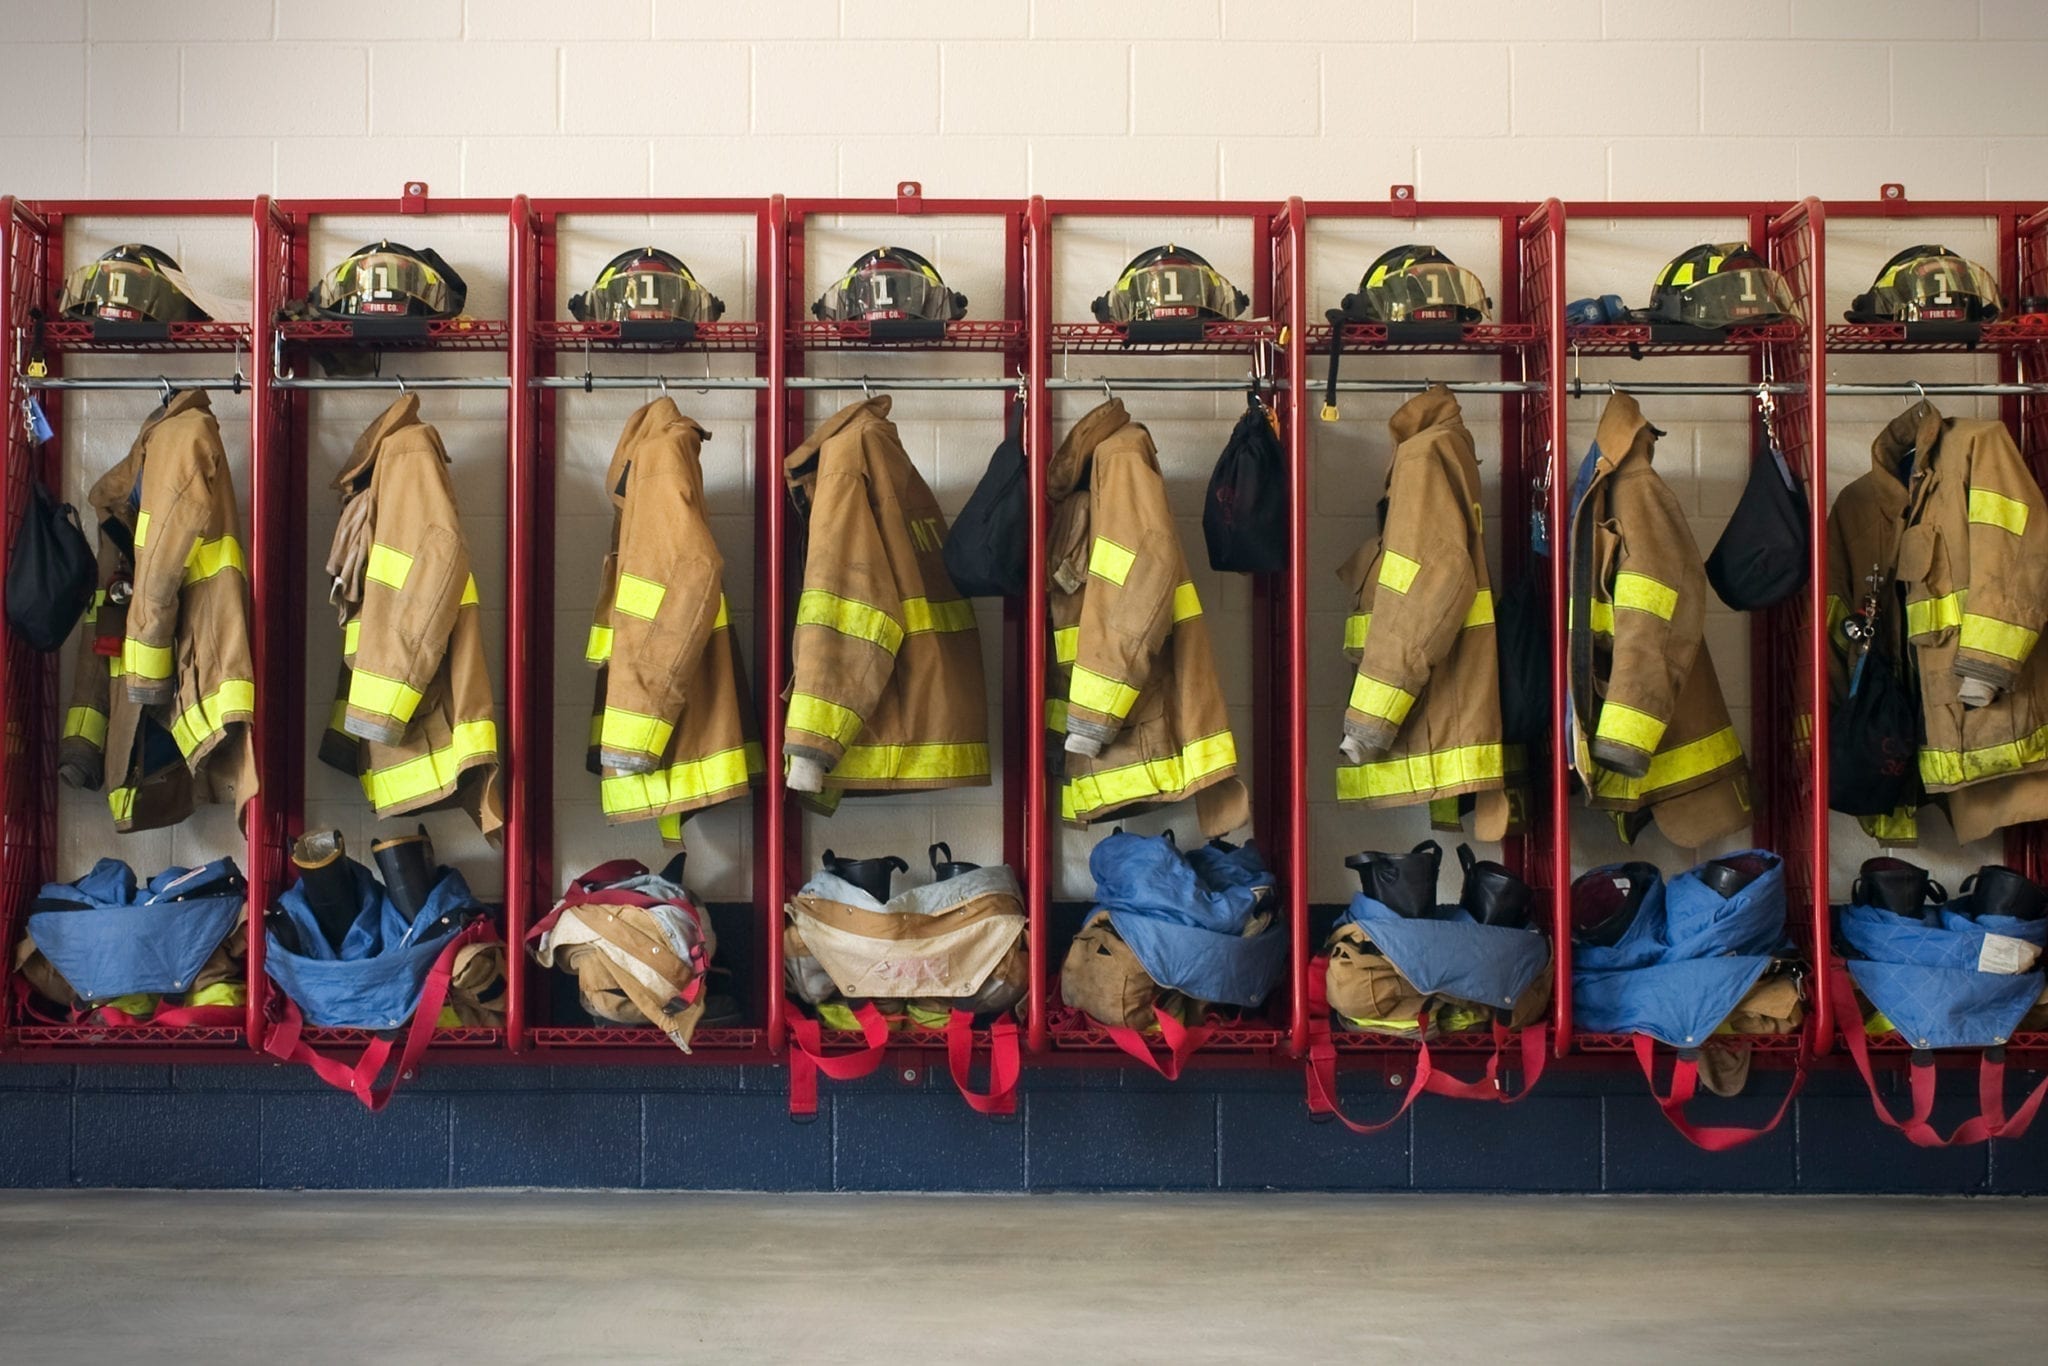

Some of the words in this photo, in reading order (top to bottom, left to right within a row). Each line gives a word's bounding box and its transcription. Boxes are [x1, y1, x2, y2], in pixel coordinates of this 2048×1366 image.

[112, 272, 129, 304] 1
[374, 267, 393, 299] 1
[640, 275, 659, 305] 1
[874, 274, 893, 305] 1
[1163, 271, 1183, 302] 1
[1426, 274, 1444, 304] 1
[1740, 271, 1757, 301] 1
[1934, 273, 1953, 305] 1
[370, 303, 385, 312] FIRE
[1161, 308, 1177, 317] FIRE
[1421, 310, 1436, 319] FIRE
[1929, 310, 1944, 319] FIRE
